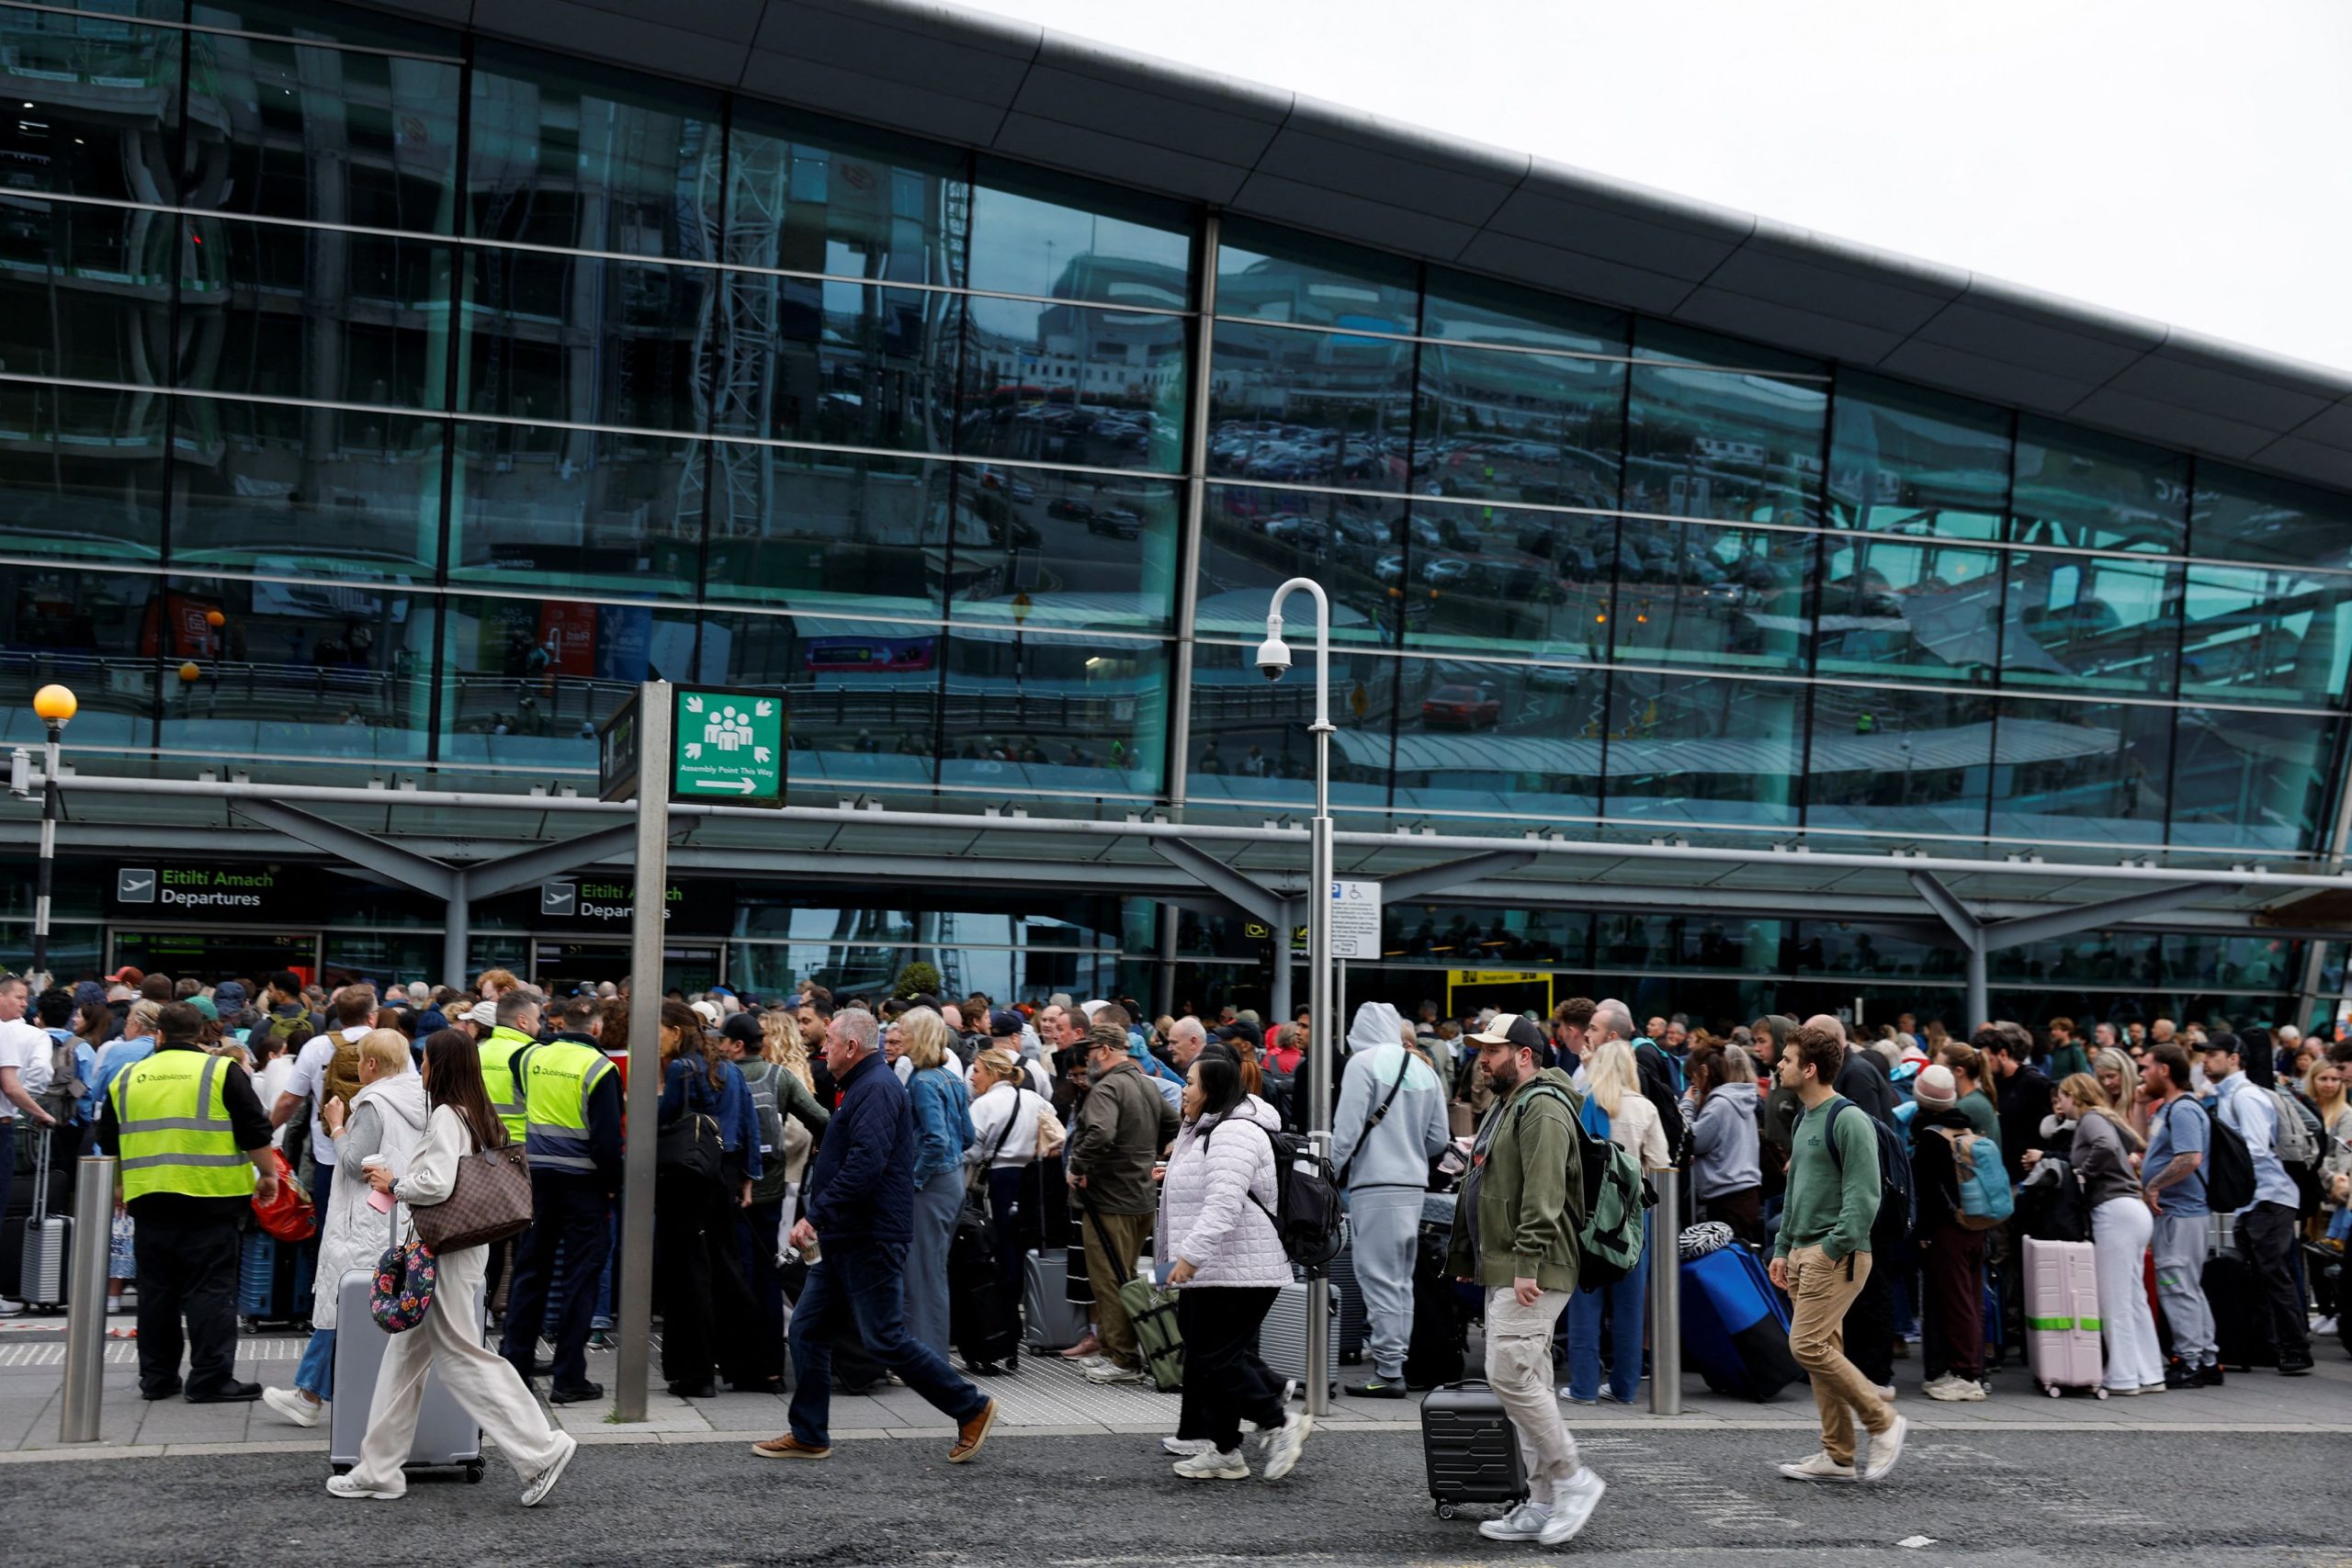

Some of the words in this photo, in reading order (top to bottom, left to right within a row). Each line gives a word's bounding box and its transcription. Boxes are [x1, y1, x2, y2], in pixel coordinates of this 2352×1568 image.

[680, 764, 717, 774] Assembly
[718, 765, 739, 774] Point
[741, 767, 756, 775] This
[757, 768, 774, 778] Way
[161, 869, 210, 886] Eitiltí
[212, 870, 274, 887] Amach
[161, 888, 261, 908] Departures
[581, 884, 625, 898] Eitiltí
[628, 885, 683, 901] Ach
[581, 902, 672, 920] Depars
